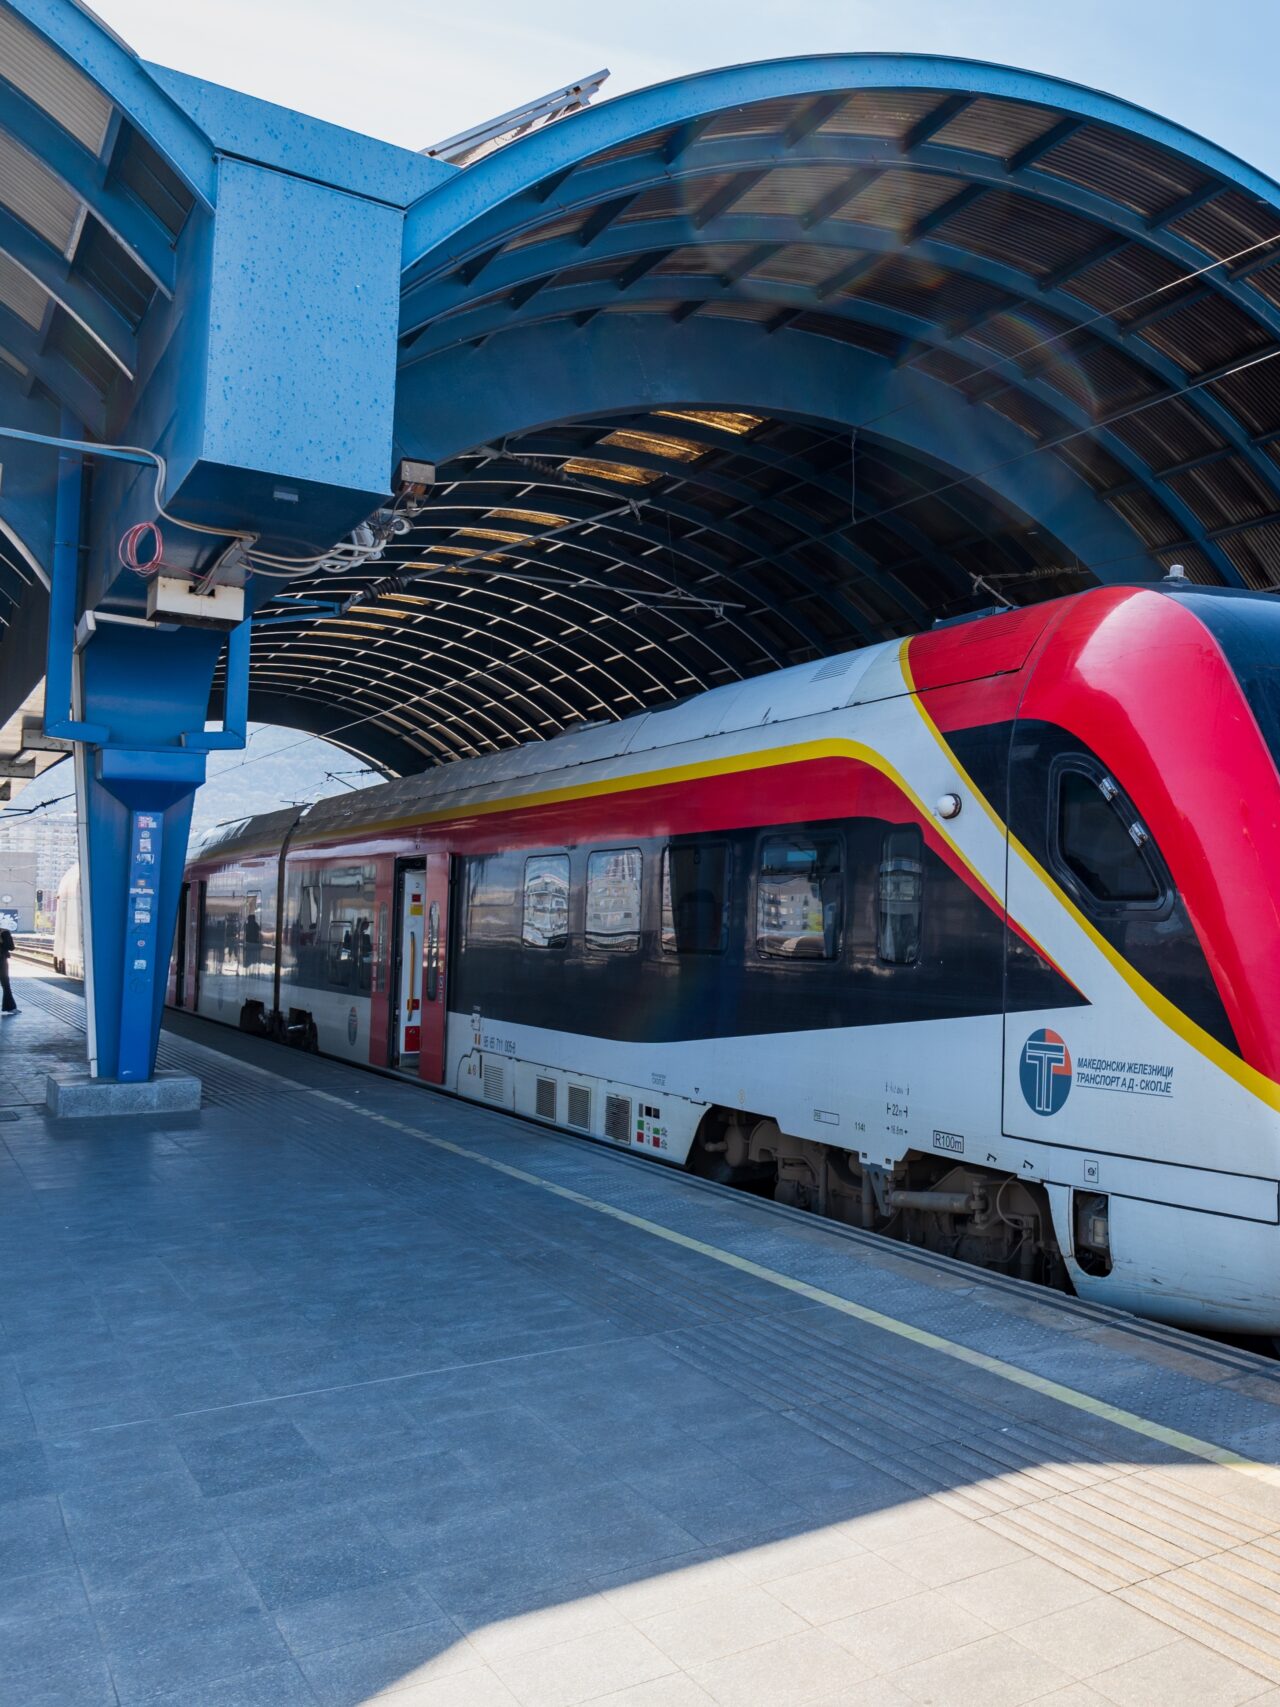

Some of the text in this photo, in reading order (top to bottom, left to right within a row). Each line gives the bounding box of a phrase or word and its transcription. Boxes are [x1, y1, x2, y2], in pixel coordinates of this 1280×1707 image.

[1077, 1057, 1174, 1080] МАКЕДОНСКИ ЖЕЛЕЗНИЦИ
[1076, 1072, 1121, 1087] ТРАНСПОРТ
[1139, 1079, 1172, 1093] СКОПЈЕ
[935, 1133, 962, 1150] R100m
